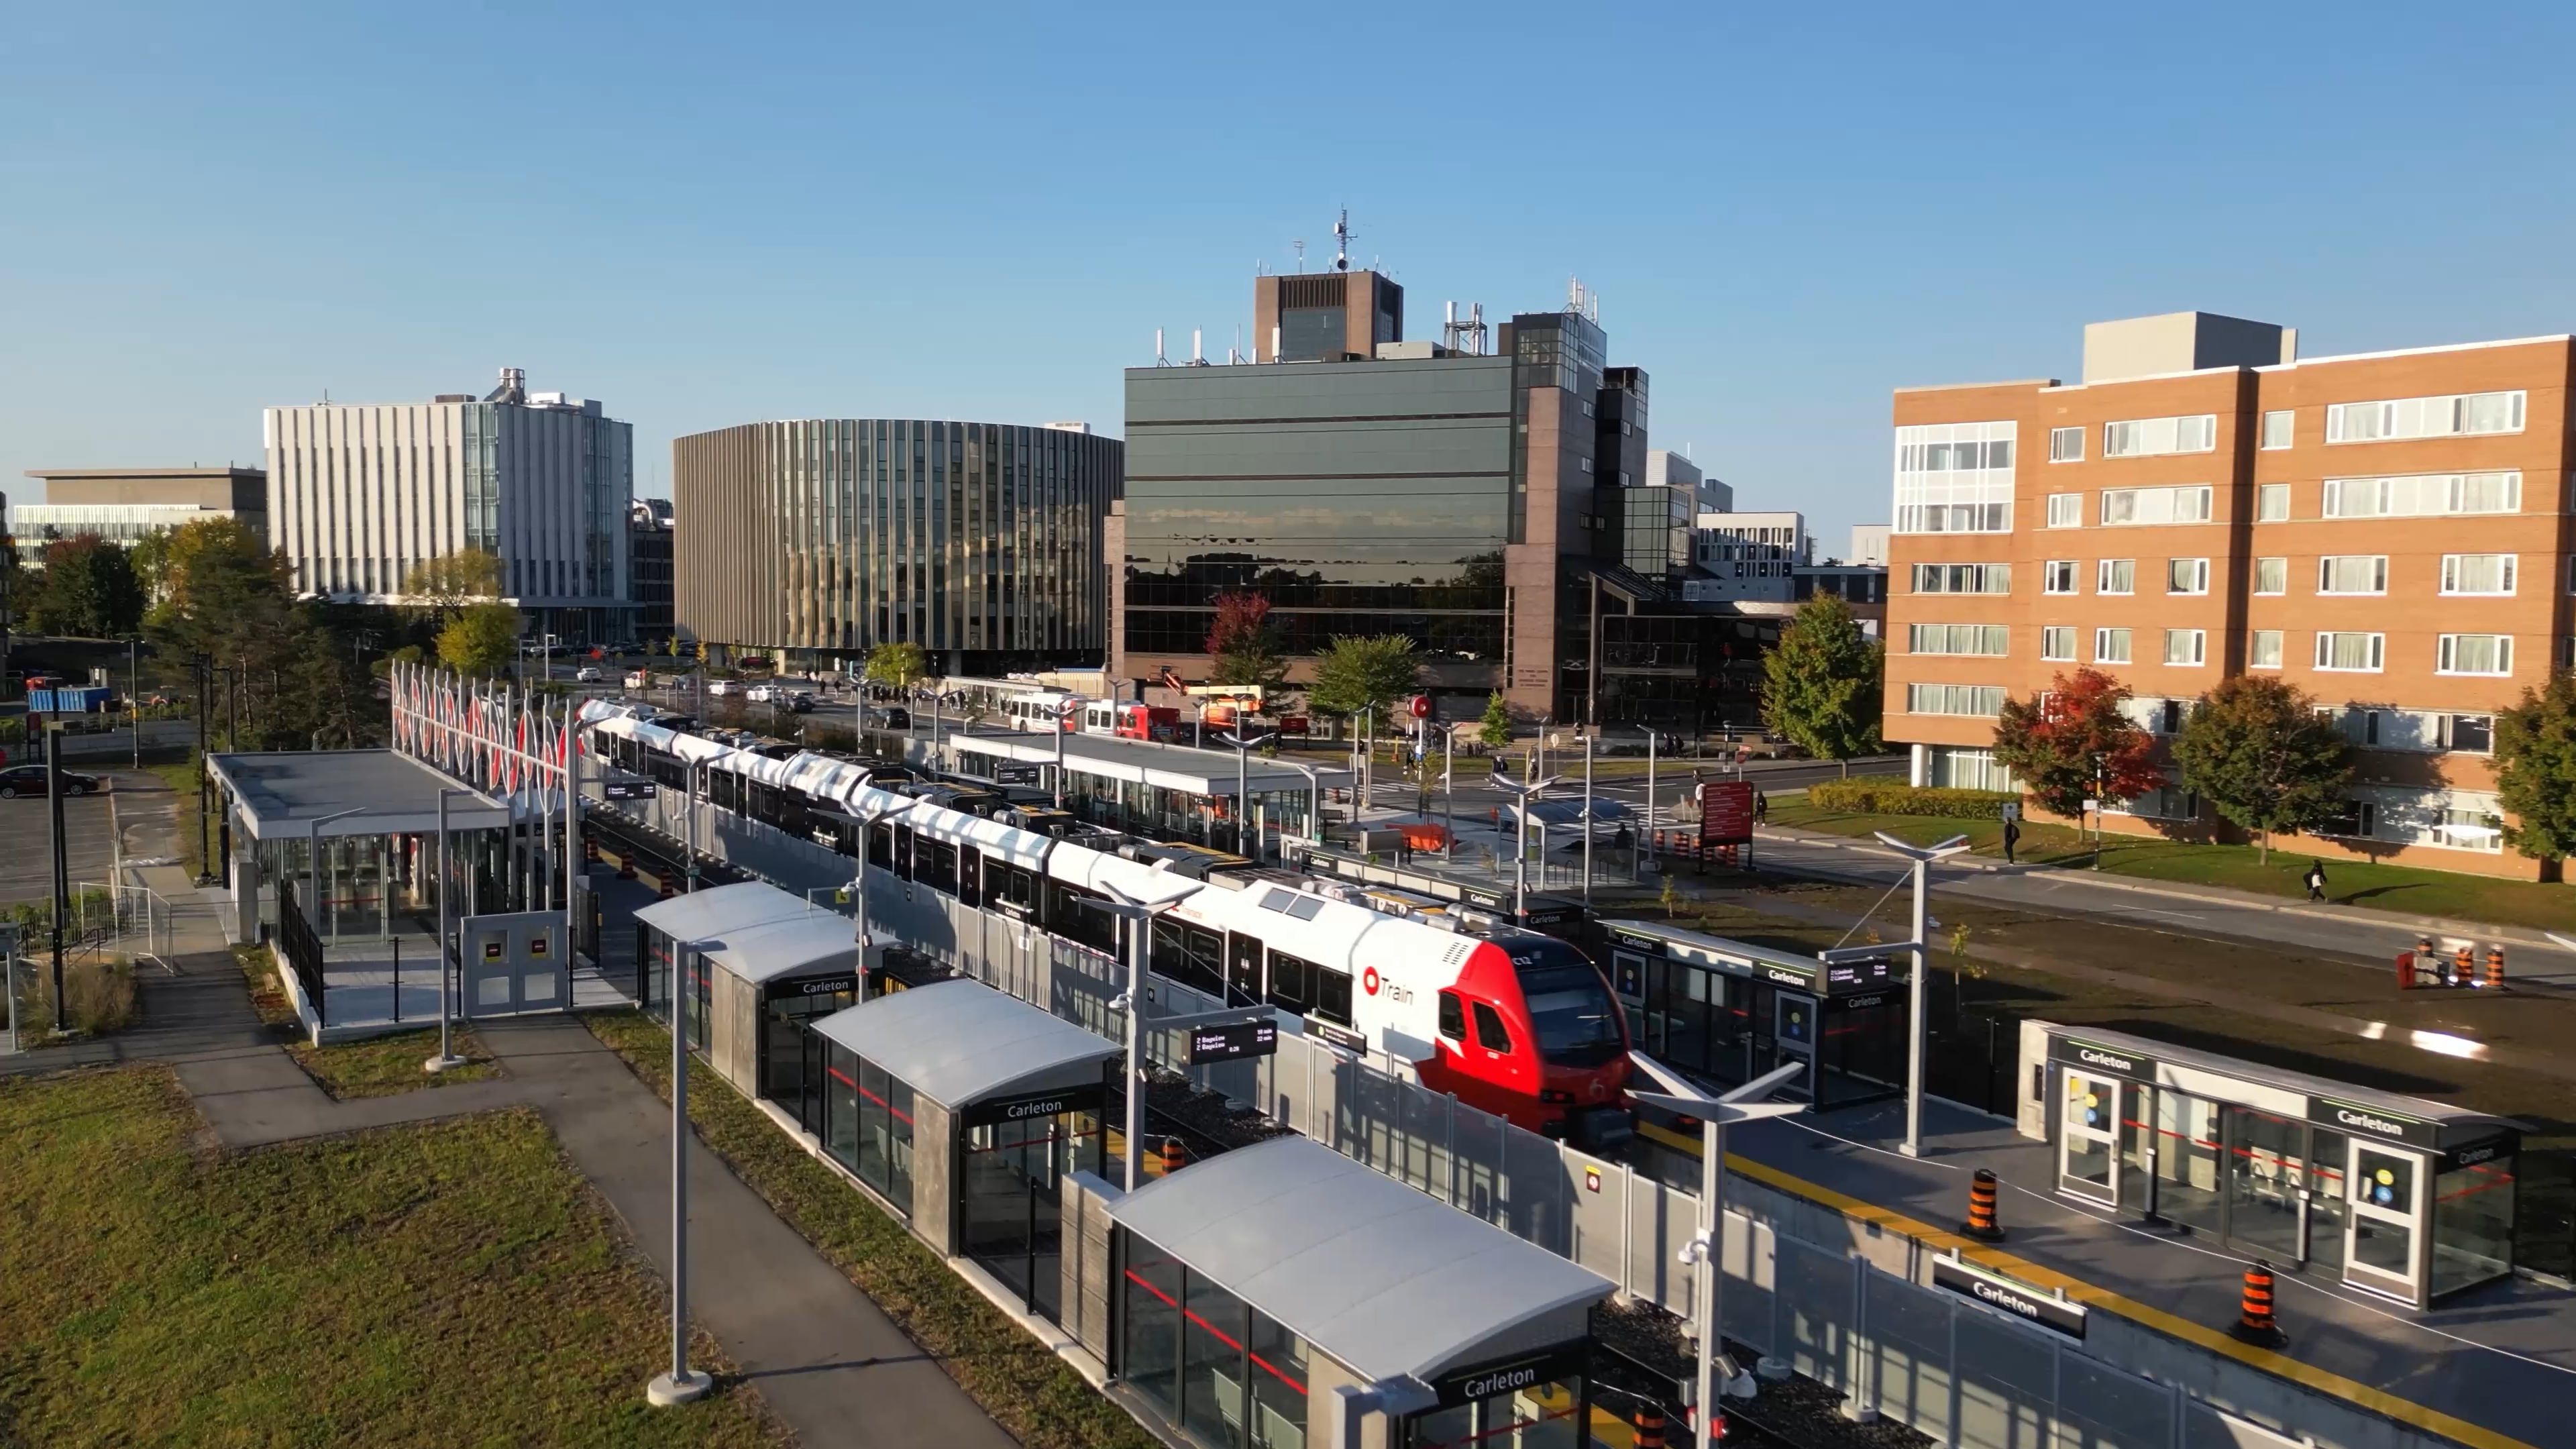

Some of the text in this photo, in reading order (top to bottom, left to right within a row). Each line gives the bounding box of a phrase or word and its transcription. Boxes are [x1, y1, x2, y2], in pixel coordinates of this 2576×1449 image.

[1310, 857, 1330, 867] Carleton
[1470, 894, 1495, 906] Carleton
[1005, 907, 1021, 919] Carleton
[1530, 914, 1560, 924] Carleton
[1622, 935, 1652, 950] Carleton
[1768, 969, 1805, 986] Carleton
[803, 981, 849, 993] Carleton
[1381, 977, 1413, 1006] Train
[1848, 996, 1882, 1008] Carleton
[1201, 1035, 1225, 1043] Bayview
[1201, 1042, 1225, 1051] Bayview
[2080, 1049, 2132, 1071] Carleton
[1008, 1102, 1062, 1118] Carleton
[2337, 1110, 2403, 1136] Carleton
[2459, 1148, 2494, 1165] Carleton
[1973, 1281, 2038, 1318] Carleton
[1464, 1368, 1534, 1398] Carleton
